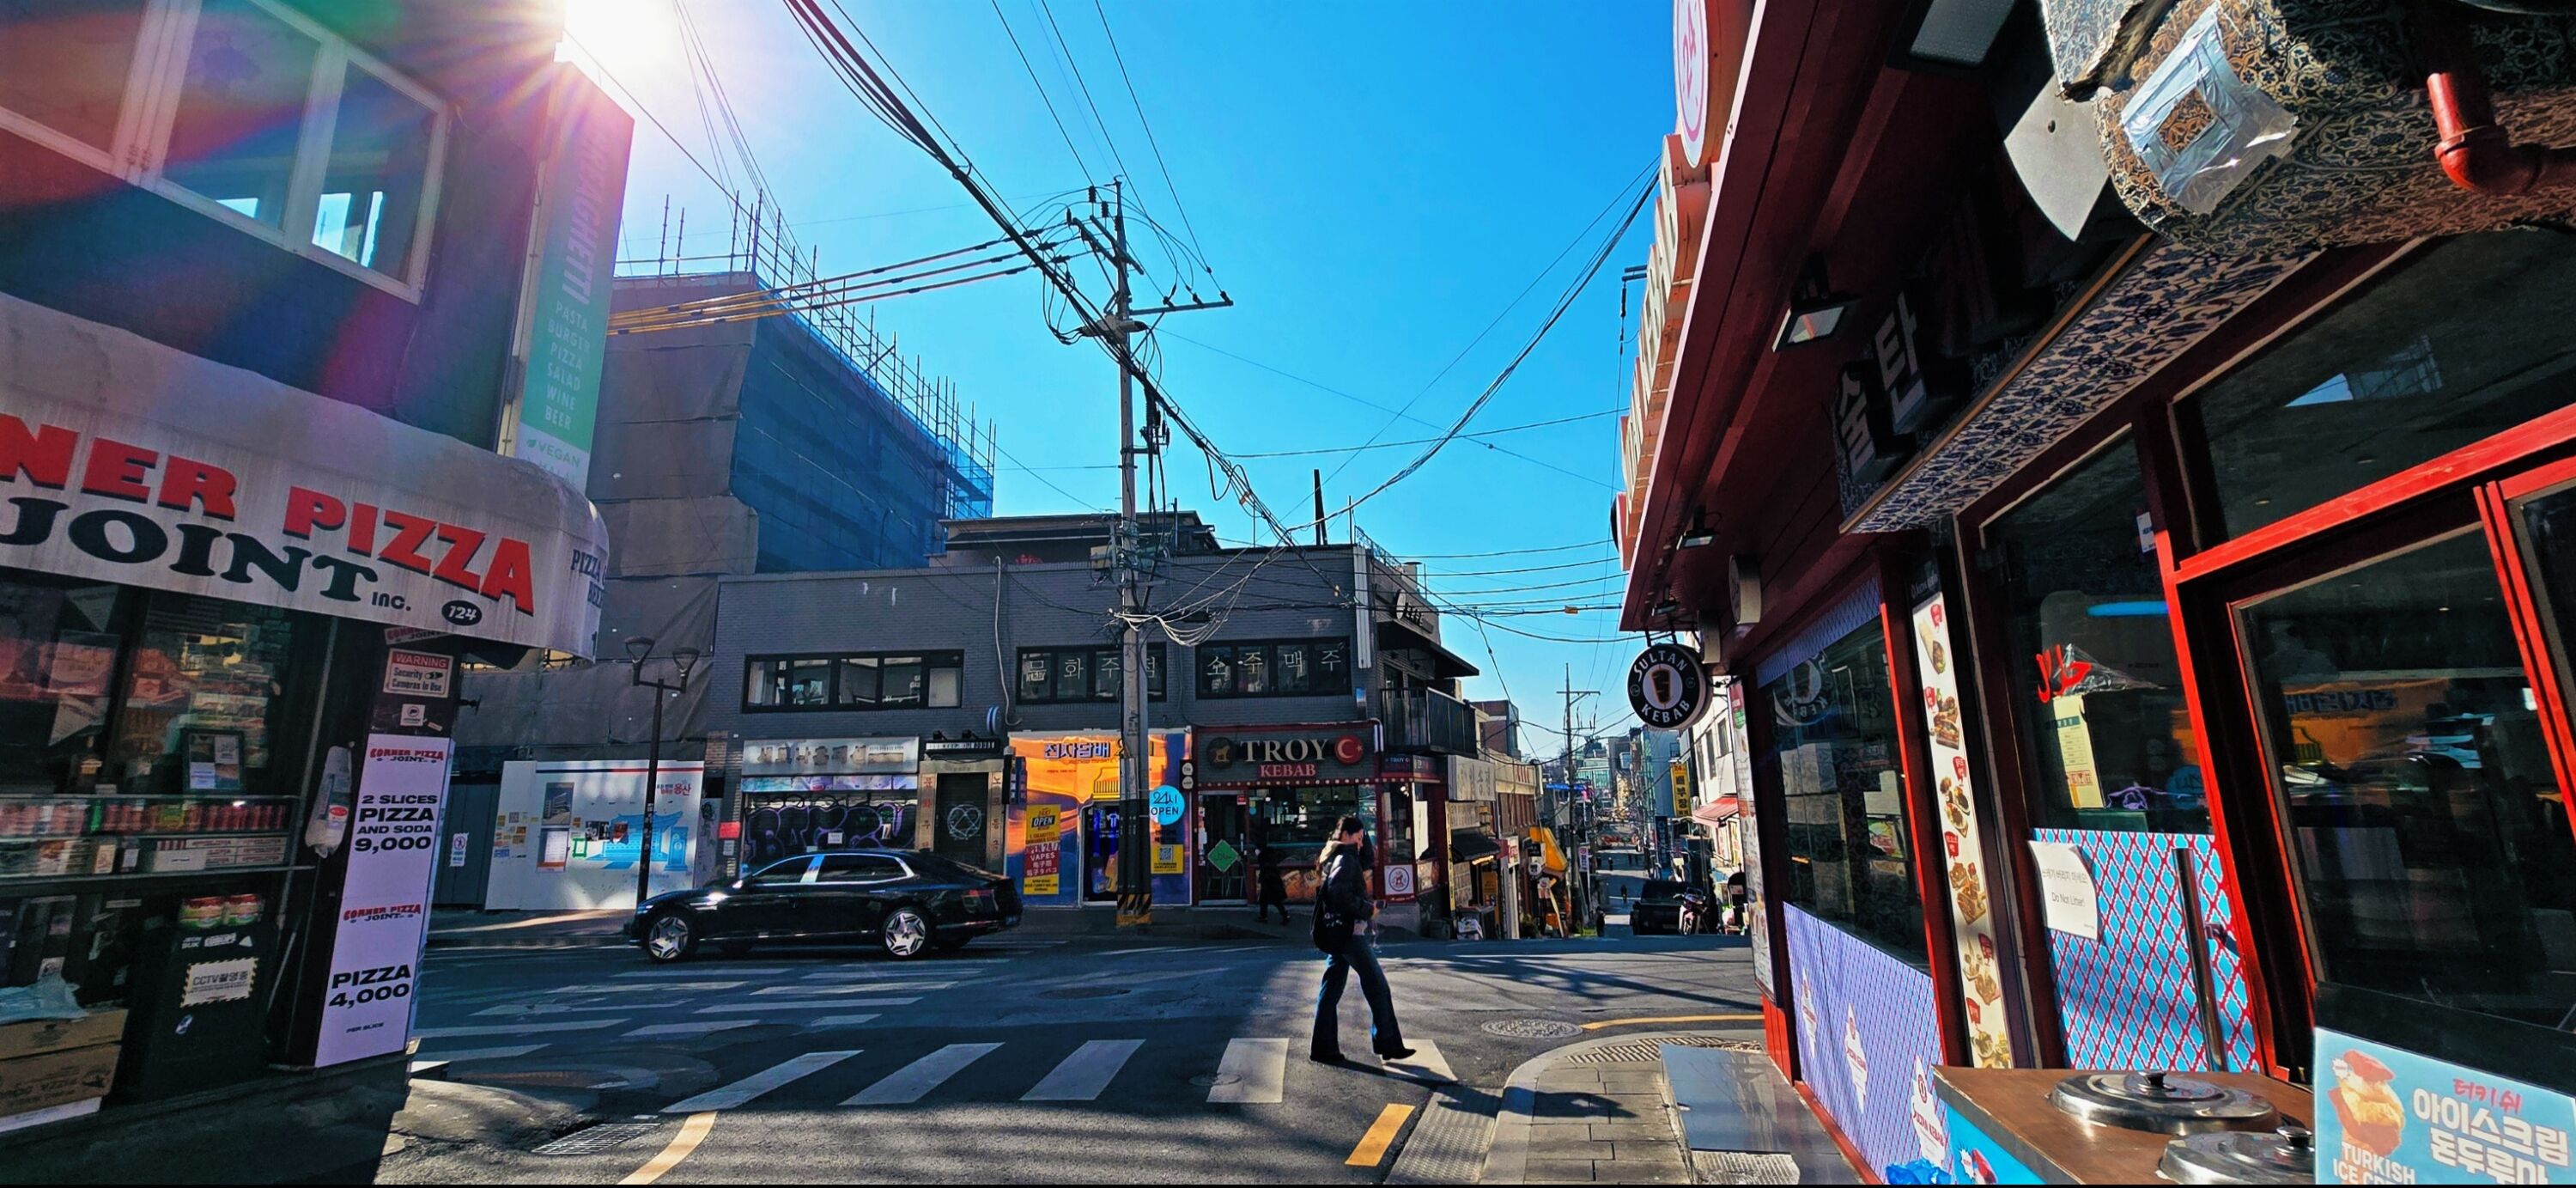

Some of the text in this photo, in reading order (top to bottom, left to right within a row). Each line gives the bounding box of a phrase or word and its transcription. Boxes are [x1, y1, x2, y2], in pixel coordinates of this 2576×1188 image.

[556, 303, 588, 332] PASTA
[548, 320, 591, 354] BURGER
[550, 341, 583, 371] PIZZA
[546, 362, 581, 392] SALAD
[546, 385, 577, 411] WINE
[544, 405, 572, 430] BEER
[538, 439, 580, 468] VEGAN
[0, 497, 380, 604] JOINT
[283, 484, 535, 618] PIZZA
[570, 549, 602, 582] PIZZA
[448, 605, 477, 621] 124
[397, 654, 447, 668] WARNING
[1633, 650, 1688, 683] SULTAN
[392, 679, 421, 691] Cameras
[430, 682, 442, 691] Use
[394, 667, 423, 680] Security
[1642, 699, 1690, 722] KEBAB
[369, 748, 444, 760] CORNER PIZZA
[1044, 741, 1110, 758] 전자담배
[1239, 739, 1328, 763] TROY
[1260, 763, 1316, 777] KEBAB
[361, 795, 438, 805] 2 SLICES
[1151, 807, 1179, 815] OPEN
[358, 807, 434, 822] PIZZA
[1033, 816, 1054, 827] OPEN
[356, 825, 433, 835] AND SODA
[355, 836, 432, 855] 9,000
[1030, 852, 1056, 862] VAPES
[2050, 892, 2059, 903] Do
[2059, 893, 2069, 905] Not
[343, 904, 422, 921] CORNER PIZZA
[364, 913, 401, 922] JOINT
[331, 964, 411, 990] PIZZA
[328, 984, 410, 1009] 4,000
[2452, 1078, 2522, 1114] 터키쉬
[2413, 1087, 2570, 1167] 아이스크림
[2332, 1157, 2359, 1185] ICE
[2341, 1141, 2416, 1185] TURKISH
